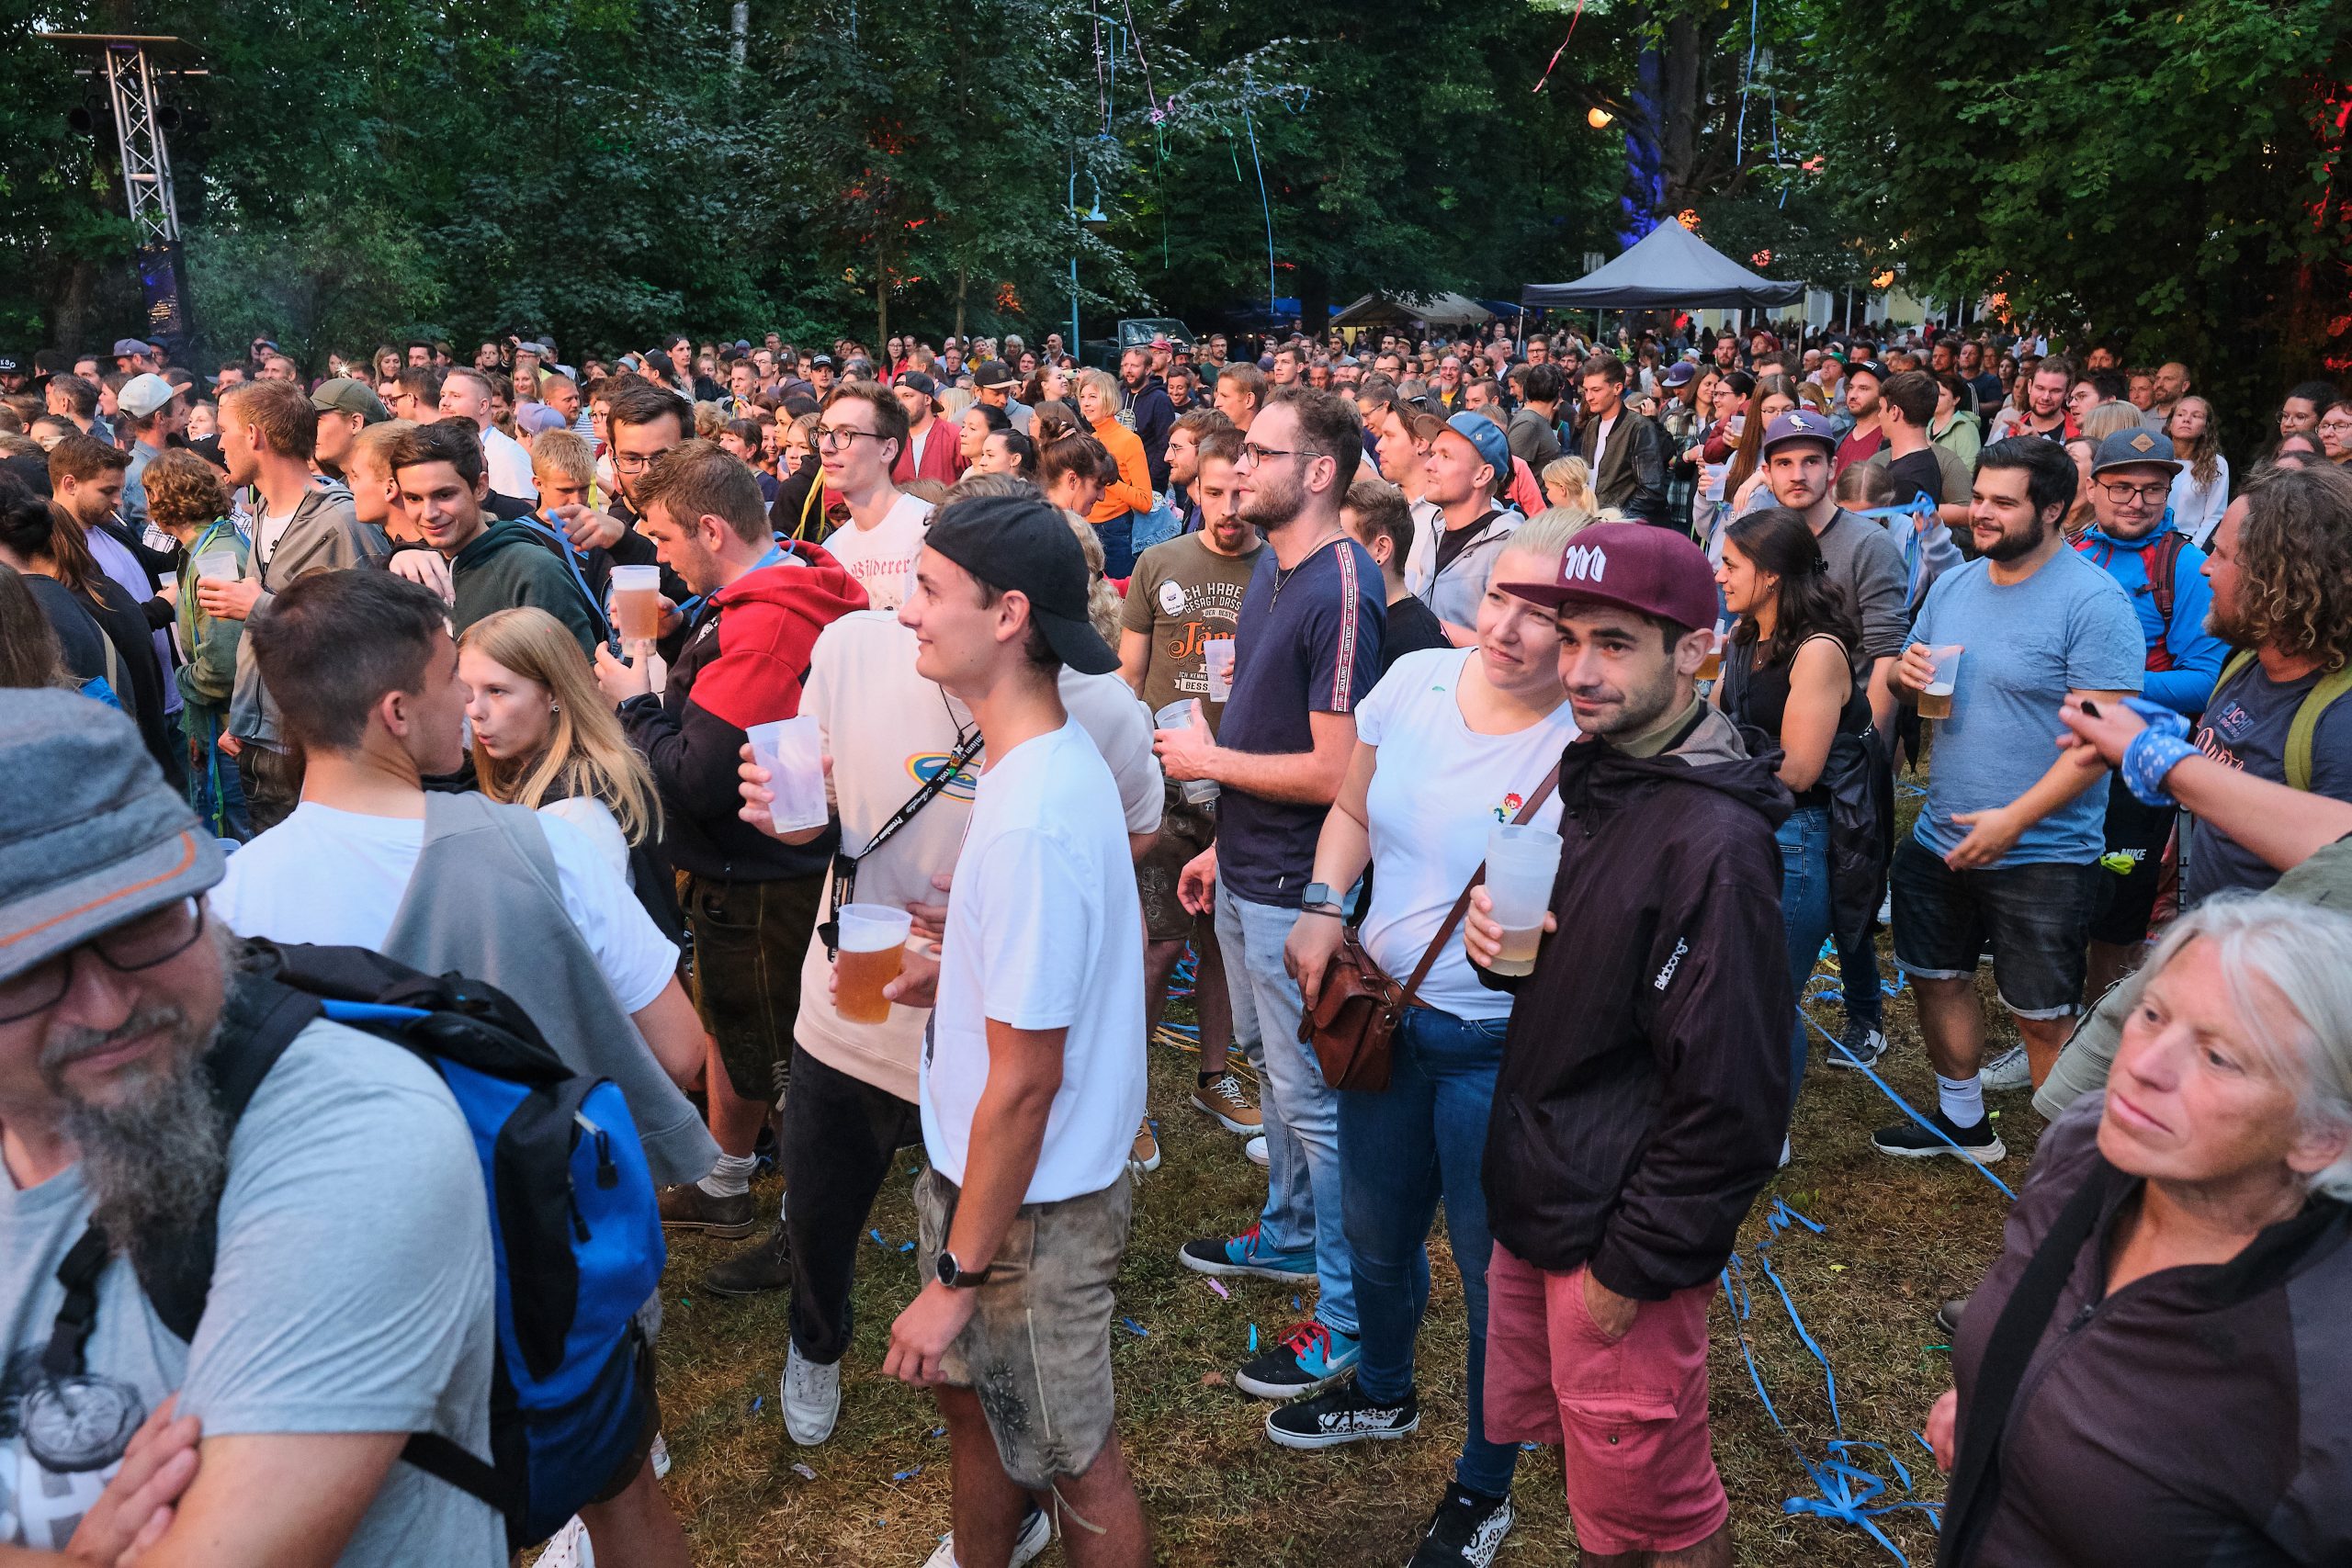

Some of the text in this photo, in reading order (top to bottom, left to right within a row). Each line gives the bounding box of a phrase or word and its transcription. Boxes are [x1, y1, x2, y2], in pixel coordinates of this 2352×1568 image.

[1182, 581, 1244, 602] CH HABE
[1183, 595, 1216, 615] GESAGT
[1219, 596, 1242, 612] DASS
[1184, 681, 1210, 692] BESS
[1654, 937, 1689, 991] Billabong
